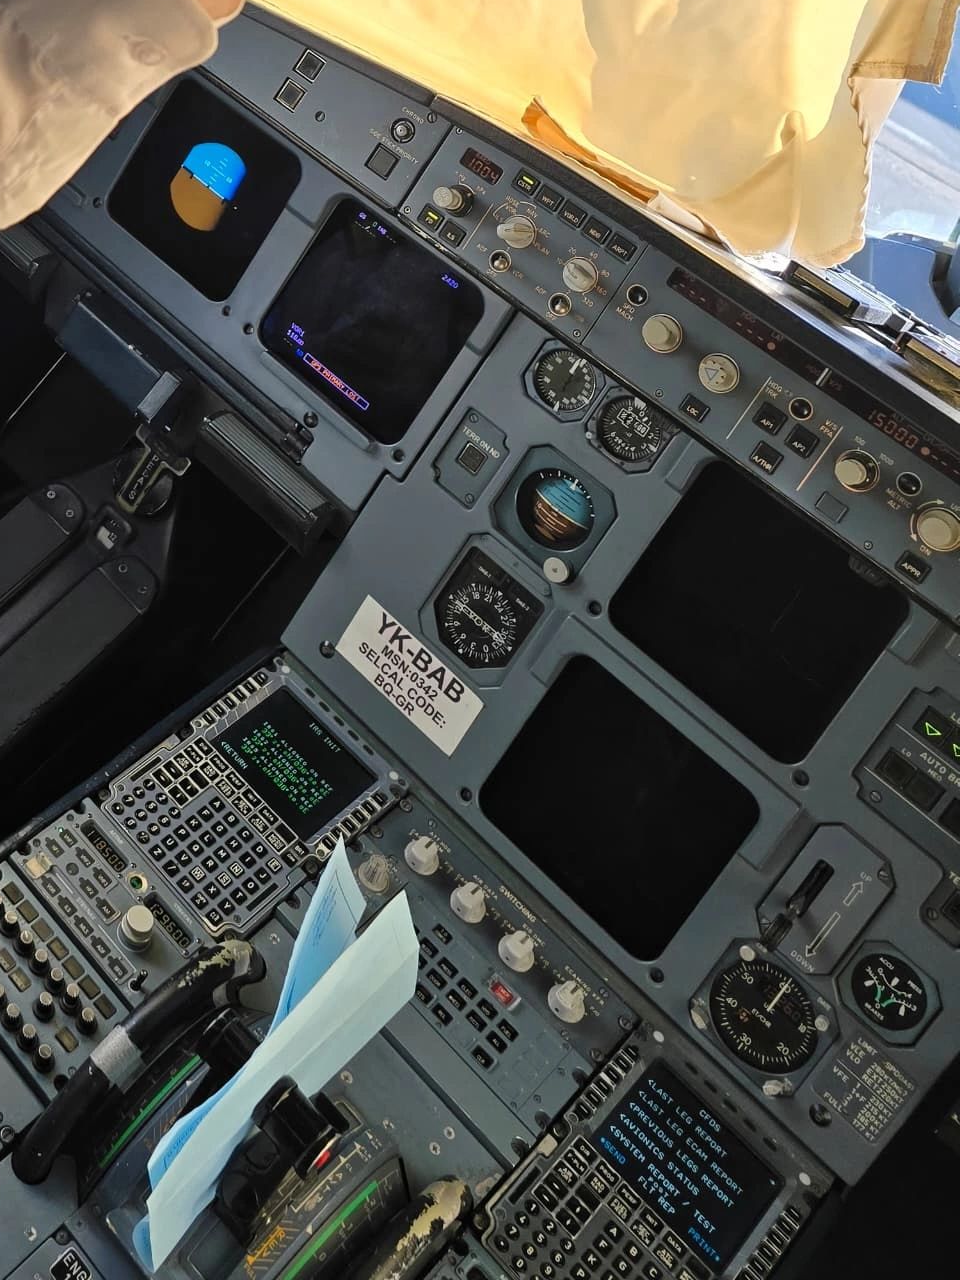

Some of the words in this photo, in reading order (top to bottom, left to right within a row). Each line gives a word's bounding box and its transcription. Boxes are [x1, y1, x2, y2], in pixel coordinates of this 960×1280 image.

[401, 106, 425, 124] CHRONO
[396, 146, 420, 165] PRIORITY
[470, 160, 500, 184] 1004
[517, 180, 532, 192] CSTR
[542, 195, 554, 207] WPT
[612, 244, 628, 256] ARPT
[616, 306, 634, 322] MACH
[623, 302, 635, 314] SPD
[310, 359, 321, 370] GPS
[321, 366, 345, 392] PRIMARY
[345, 387, 360, 402] LOST
[768, 380, 782, 393] HDG
[765, 387, 778, 400] TRK
[686, 404, 699, 417] LOC
[760, 418, 774, 429] AP1
[819, 425, 834, 438] FPA
[868, 410, 919, 449] 15000
[462, 426, 480, 444] TERR
[480, 440, 490, 452] ON
[490, 448, 500, 460] ND
[792, 441, 806, 453] AP2
[752, 455, 772, 471] A/THR
[880, 452, 894, 466] 1000
[886, 488, 912, 509] METRIC
[887, 499, 900, 510] ALT
[900, 562, 921, 578] APPR
[472, 592, 480, 600] 18
[484, 594, 492, 603] 21
[494, 602, 503, 612] 24
[500, 616, 510, 626] 27
[482, 644, 489, 652] 0
[377, 611, 465, 704] YK-BAB
[381, 645, 438, 702] MSN:0342
[359, 642, 403, 694] SELCAL
[407, 688, 446, 728] CODE:
[374, 673, 415, 716] BQ-GR
[324, 736, 340, 752] INIT
[270, 748, 297, 774] ALIGNED
[280, 740, 307, 766] ALIGNED
[260, 756, 287, 782] ALIGNED
[919, 752, 947, 775] AUTO
[928, 768, 942, 782] MED
[262, 809, 275, 822] DATA
[860, 871, 873, 883] UP
[500, 885, 537, 922] SWITCHING
[790, 950, 815, 972] DOWN
[879, 957, 894, 970] ACCU
[740, 972, 754, 984] 50
[460, 984, 472, 996] ELEC
[726, 997, 738, 1008] 40
[740, 1032, 752, 1046] 30
[858, 1036, 878, 1056] LIMIT
[776, 1042, 790, 1056] 20
[850, 1042, 866, 1058] VLE
[833, 1066, 850, 1084] VFE
[846, 1048, 861, 1064] VLO
[866, 1068, 882, 1084] EXT
[881, 1082, 904, 1104] 250KT
[862, 1074, 880, 1092] RET
[876, 1086, 898, 1110] 220KT
[824, 1092, 842, 1112] FULL
[699, 1109, 720, 1132] CFDS
[675, 1106, 693, 1125] LEG
[694, 1126, 728, 1158] REPORT
[580, 1144, 590, 1156] DIR
[666, 1118, 684, 1136] LEG
[686, 1138, 709, 1162] ECAM
[710, 1162, 744, 1196] REPORT
[598, 1165, 616, 1182] PROG
[667, 1162, 700, 1196] STATUS
[676, 1150, 700, 1174] LEGS
[700, 1174, 734, 1208] REPORT
[620, 1188, 637, 1205] PERF
[638, 1175, 656, 1195] FLT
[657, 1196, 677, 1214] REP
[647, 1163, 680, 1197] REPORT
[693, 1209, 716, 1234] TEST
[644, 1213, 658, 1227] INIT
[666, 1236, 683, 1253] DATA
[62, 1252, 88, 1280] ENG
